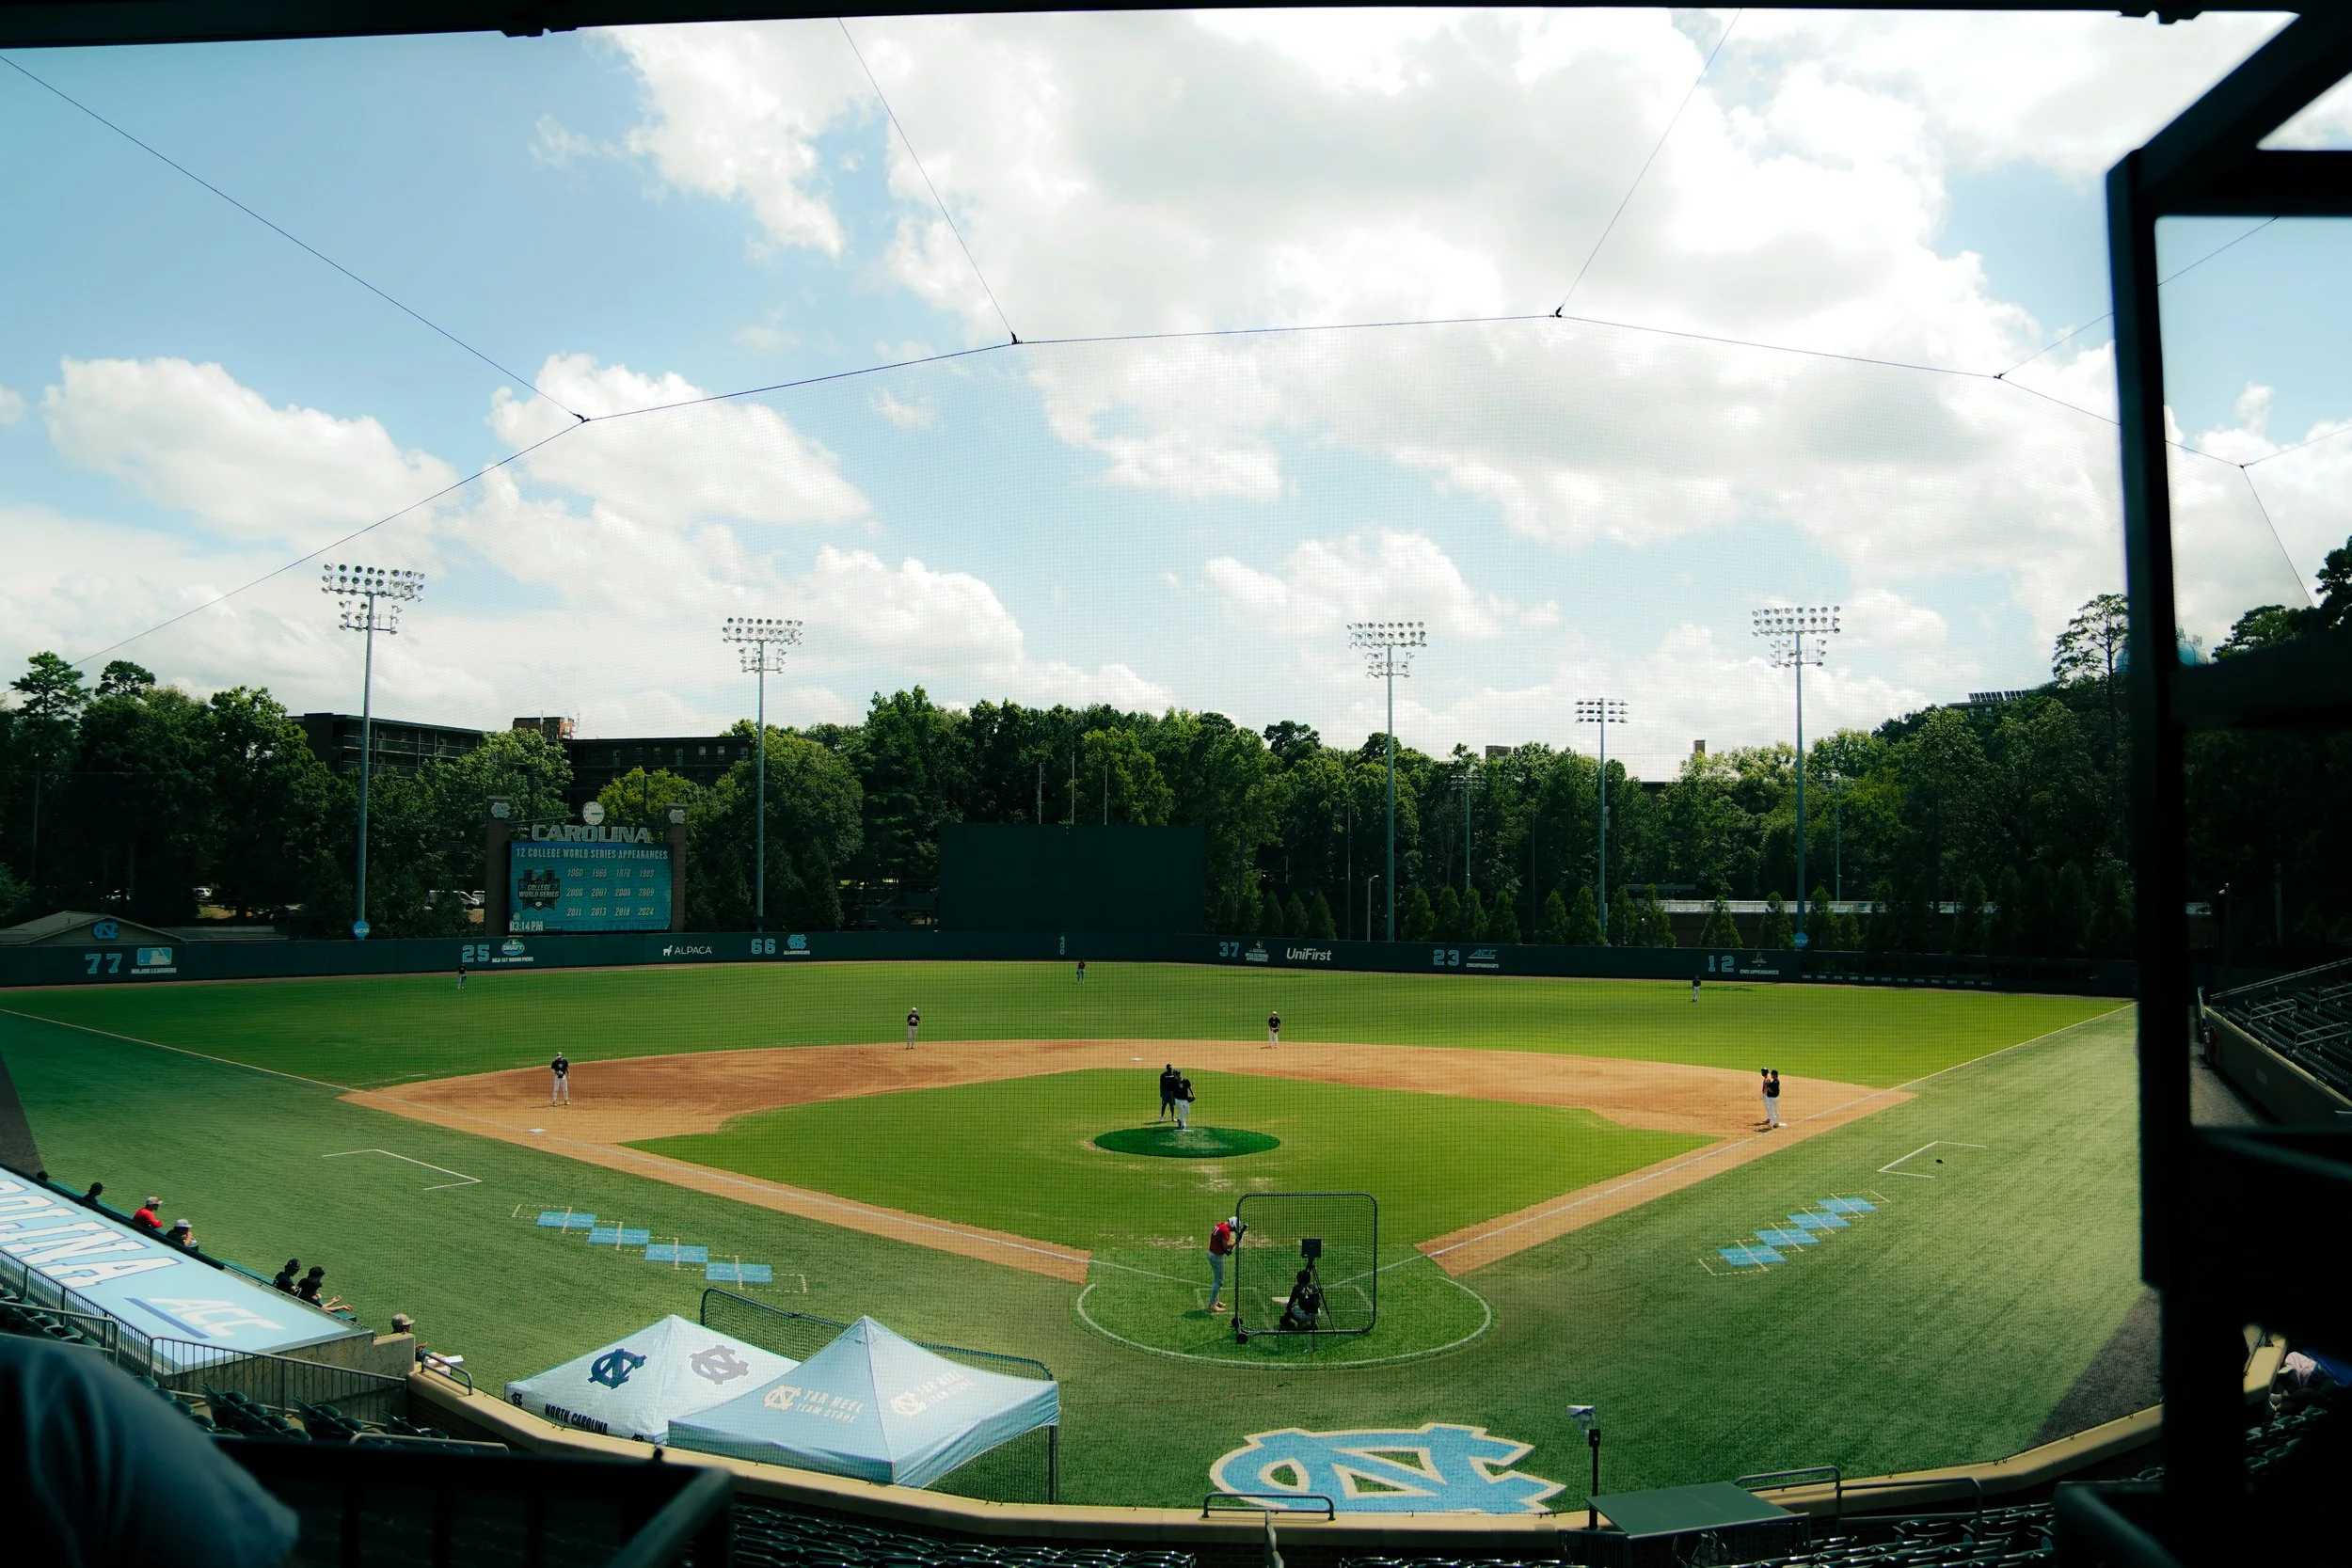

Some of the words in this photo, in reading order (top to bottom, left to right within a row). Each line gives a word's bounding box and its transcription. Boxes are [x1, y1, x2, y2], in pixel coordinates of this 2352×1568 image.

[531, 824, 653, 844] CAROLINA
[516, 847, 526, 858] 12
[528, 847, 561, 859] COLLEGE
[564, 848, 589, 859] WORLD
[591, 848, 616, 860] SERIES
[618, 848, 668, 861] APPEARANCES
[591, 888, 608, 897] 2007
[566, 908, 582, 917] 2011
[591, 908, 607, 917] 2013
[638, 908, 655, 916] 2024
[509, 921, 531, 932] 03:14
[532, 921, 544, 932] PM
[462, 944, 490, 963] 25
[675, 945, 712, 955] ALPACA
[751, 939, 776, 955] 66
[1218, 942, 1240, 958] 37
[1286, 947, 1332, 961] UniFirst
[85, 953, 122, 974] 77
[1433, 949, 1460, 966] 23
[1708, 955, 1735, 973] 12
[0, 1180, 184, 1290] OLINA
[148, 1297, 286, 1337] ACC
[804, 1390, 829, 1404] TAR
[830, 1396, 865, 1414] HEEL
[545, 1403, 570, 1423] NORTH
[571, 1412, 609, 1433] CAROLINA
[795, 1402, 823, 1415] TEAM
[823, 1409, 857, 1423] STORE
